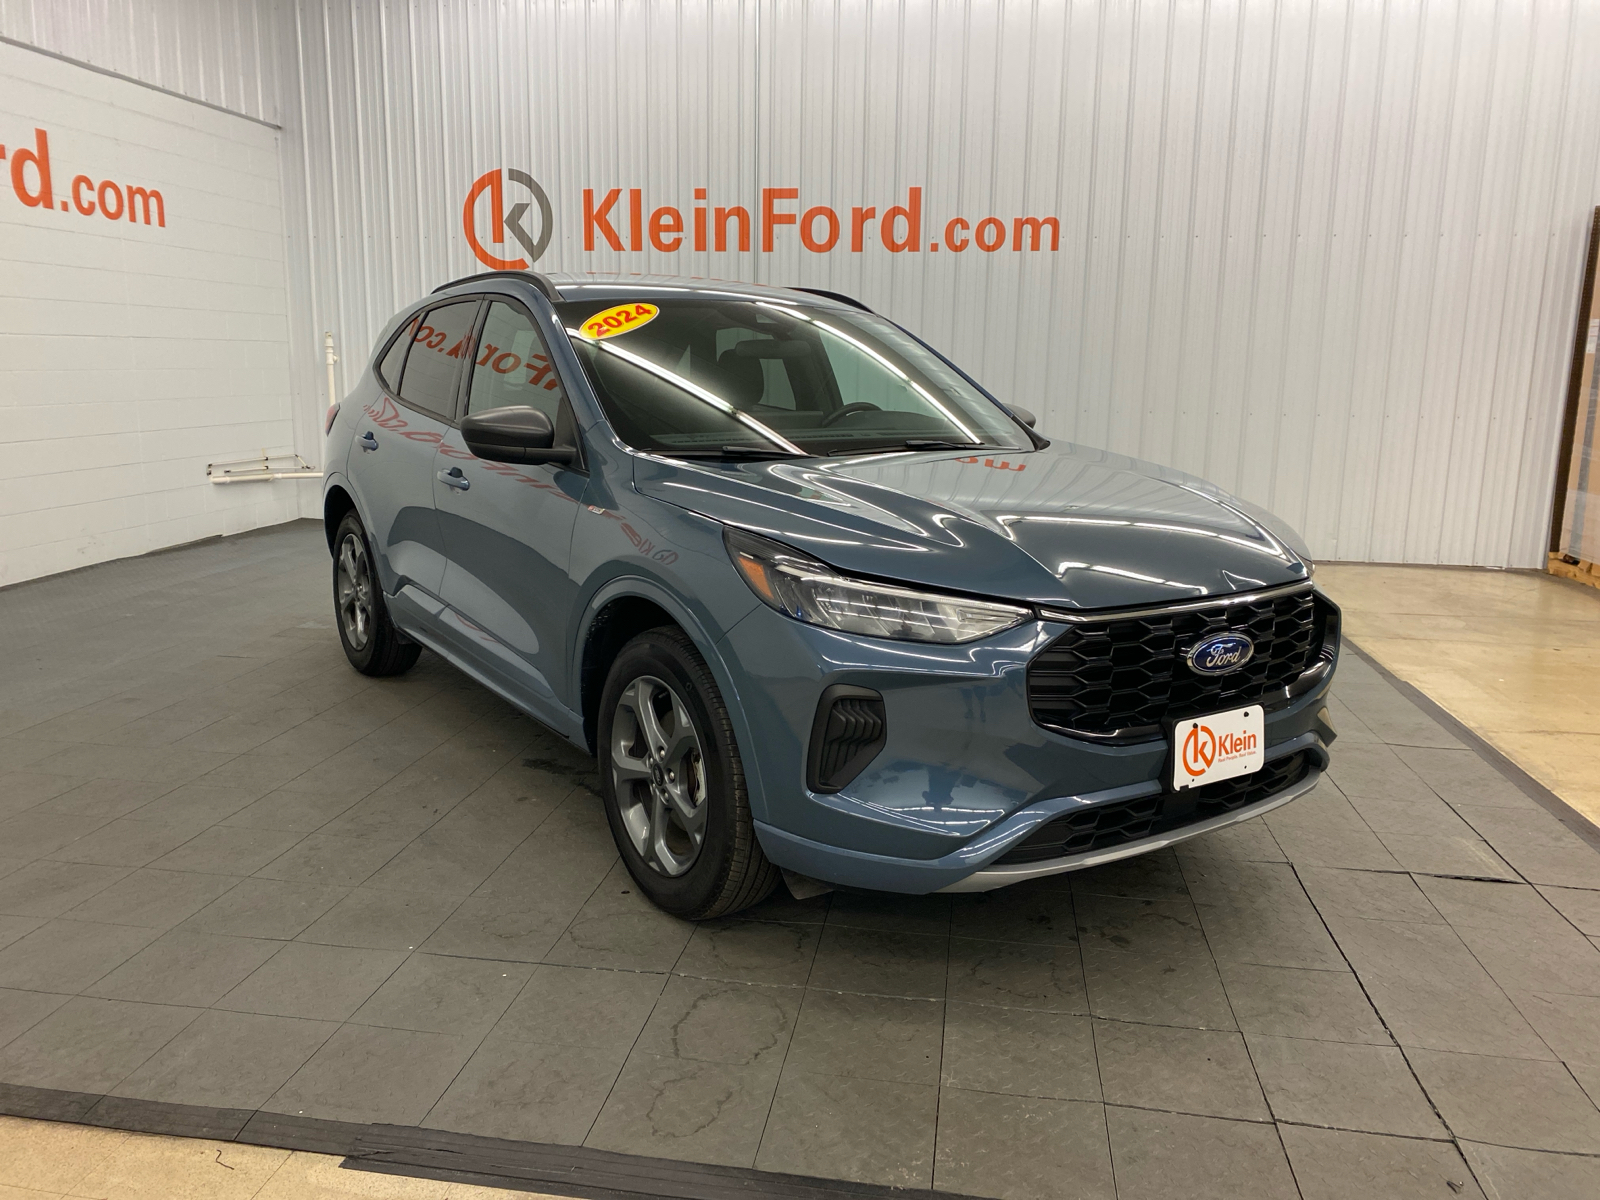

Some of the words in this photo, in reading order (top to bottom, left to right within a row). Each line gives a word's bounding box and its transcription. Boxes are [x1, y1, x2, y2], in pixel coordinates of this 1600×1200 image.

[582, 186, 1060, 253] KleinFord.com
[587, 303, 652, 337] 2024
[1206, 642, 1242, 668] Ford
[1218, 730, 1257, 757] Klein
